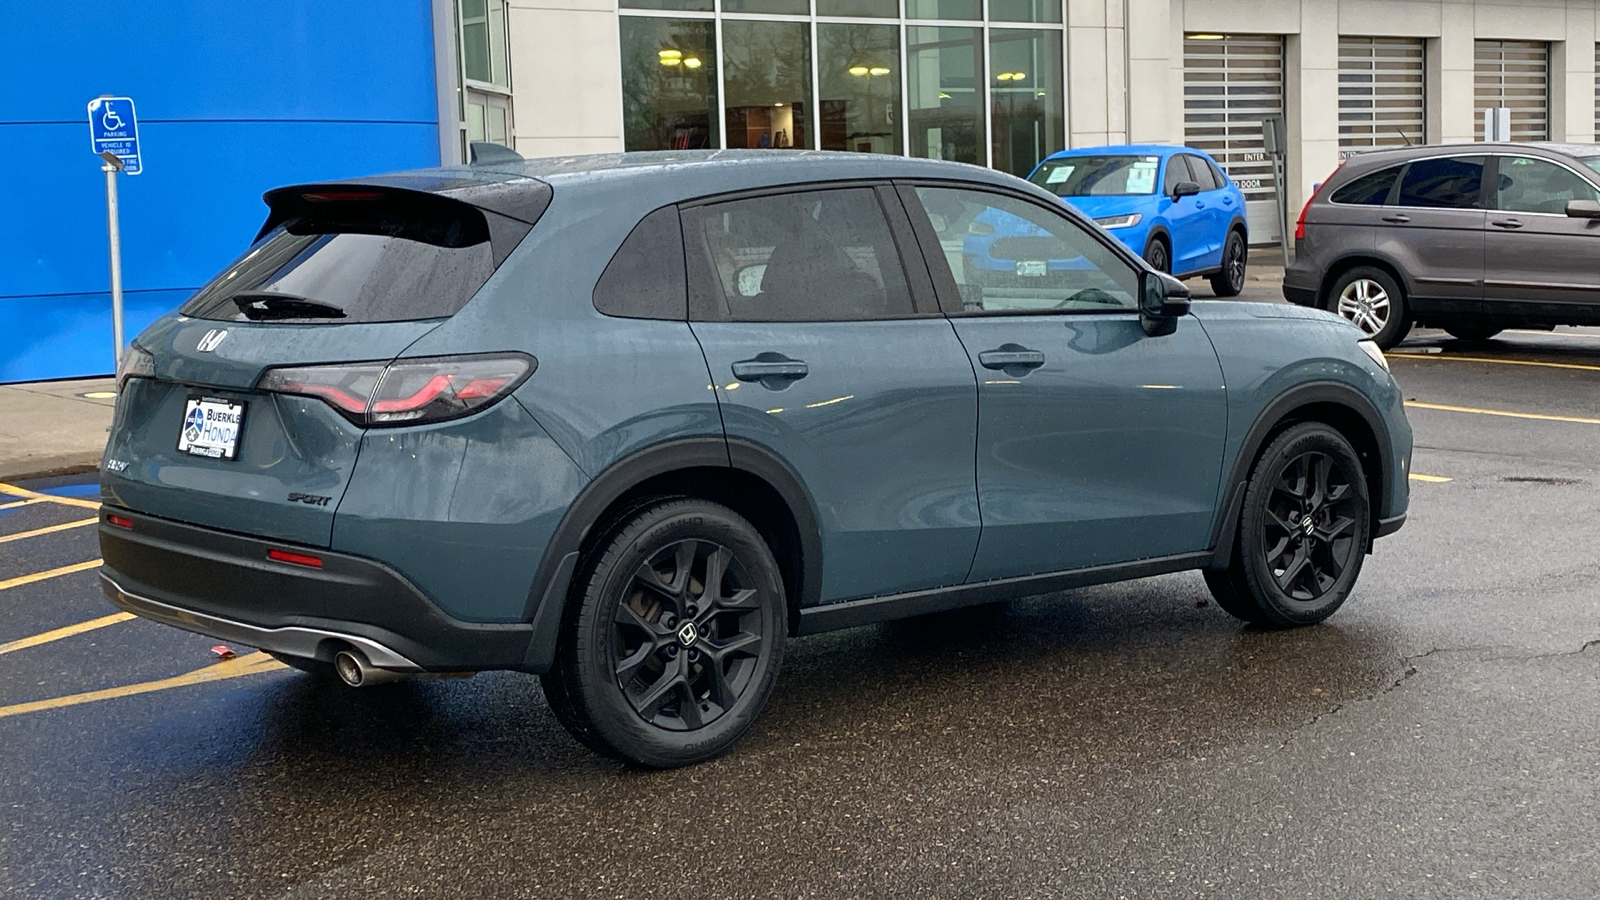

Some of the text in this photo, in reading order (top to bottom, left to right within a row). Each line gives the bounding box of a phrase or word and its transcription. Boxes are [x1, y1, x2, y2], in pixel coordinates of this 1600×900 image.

[1244, 153, 1265, 161] ENTER
[1241, 179, 1261, 188] DOOR
[206, 408, 241, 424] BUERKLE
[202, 421, 237, 444] HONDA
[287, 492, 332, 506] SPORT
